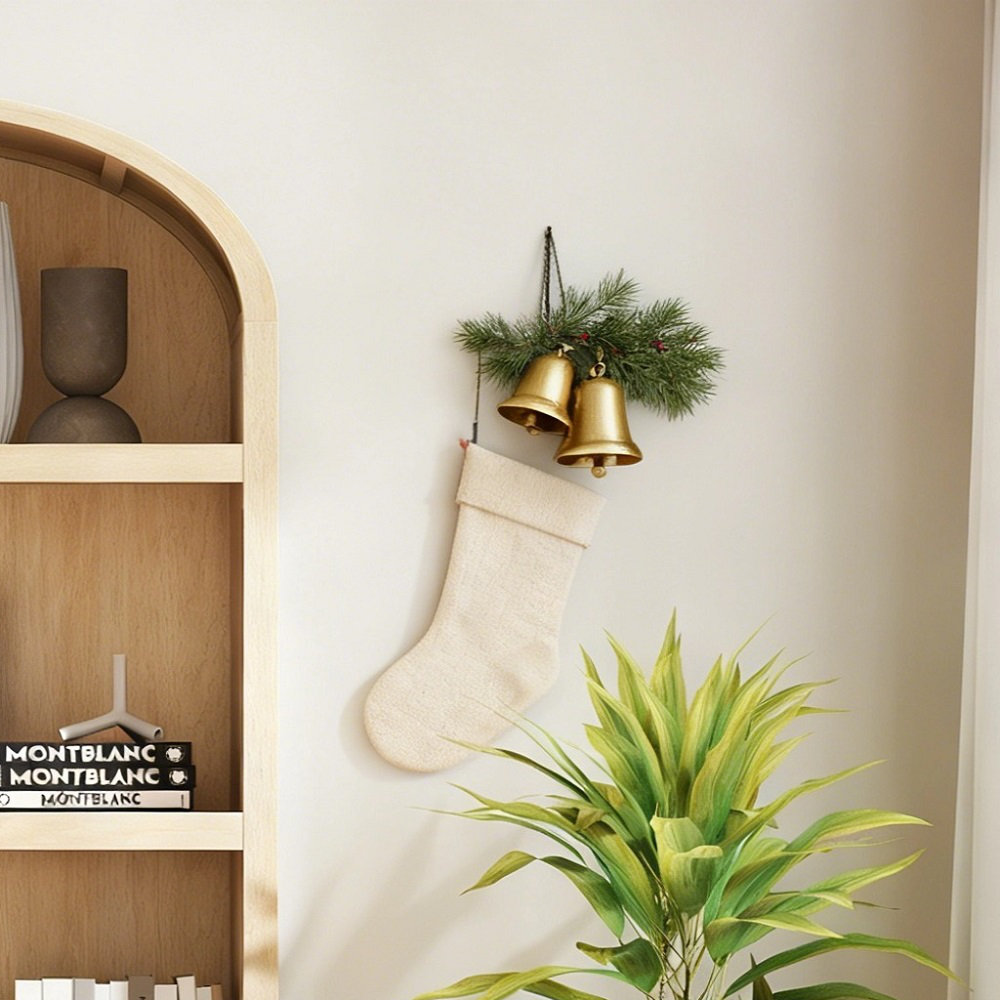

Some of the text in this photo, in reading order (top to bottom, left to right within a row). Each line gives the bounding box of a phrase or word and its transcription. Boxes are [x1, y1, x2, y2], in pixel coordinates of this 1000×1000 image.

[5, 744, 156, 763] MONTBLANC
[9, 767, 160, 786] MONTBLANC
[40, 791, 142, 806] MONTBLANC
